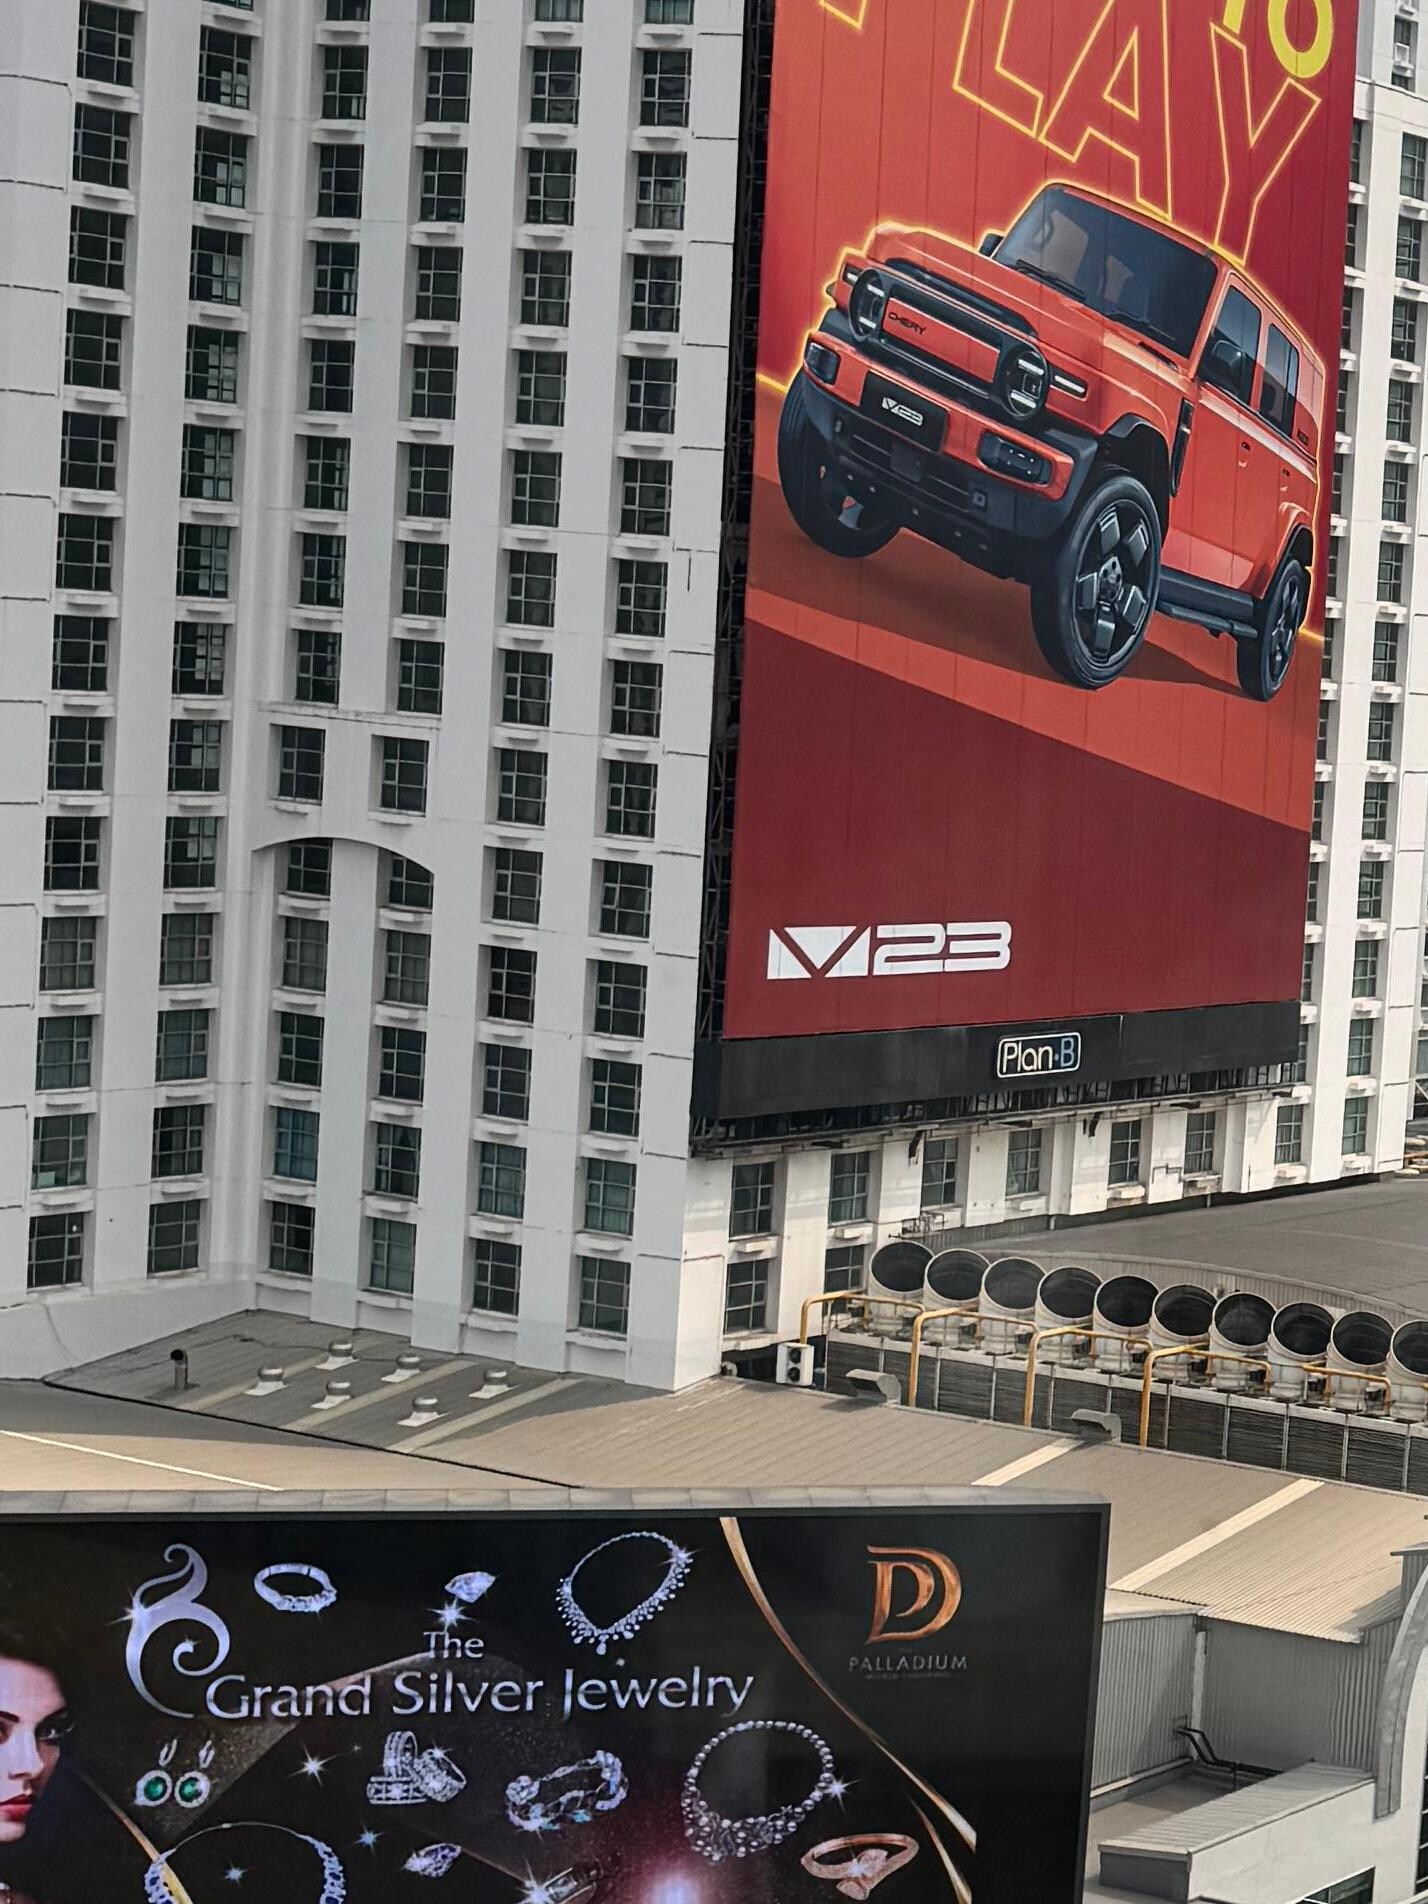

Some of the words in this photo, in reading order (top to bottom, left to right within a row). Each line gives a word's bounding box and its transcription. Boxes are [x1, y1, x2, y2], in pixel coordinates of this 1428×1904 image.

[424, 1632, 485, 1660] The
[848, 1653, 968, 1672] PALLADIUM
[205, 1674, 371, 1720] Grand
[392, 1668, 543, 1716] Silver
[561, 1666, 754, 1719] Jewelry
